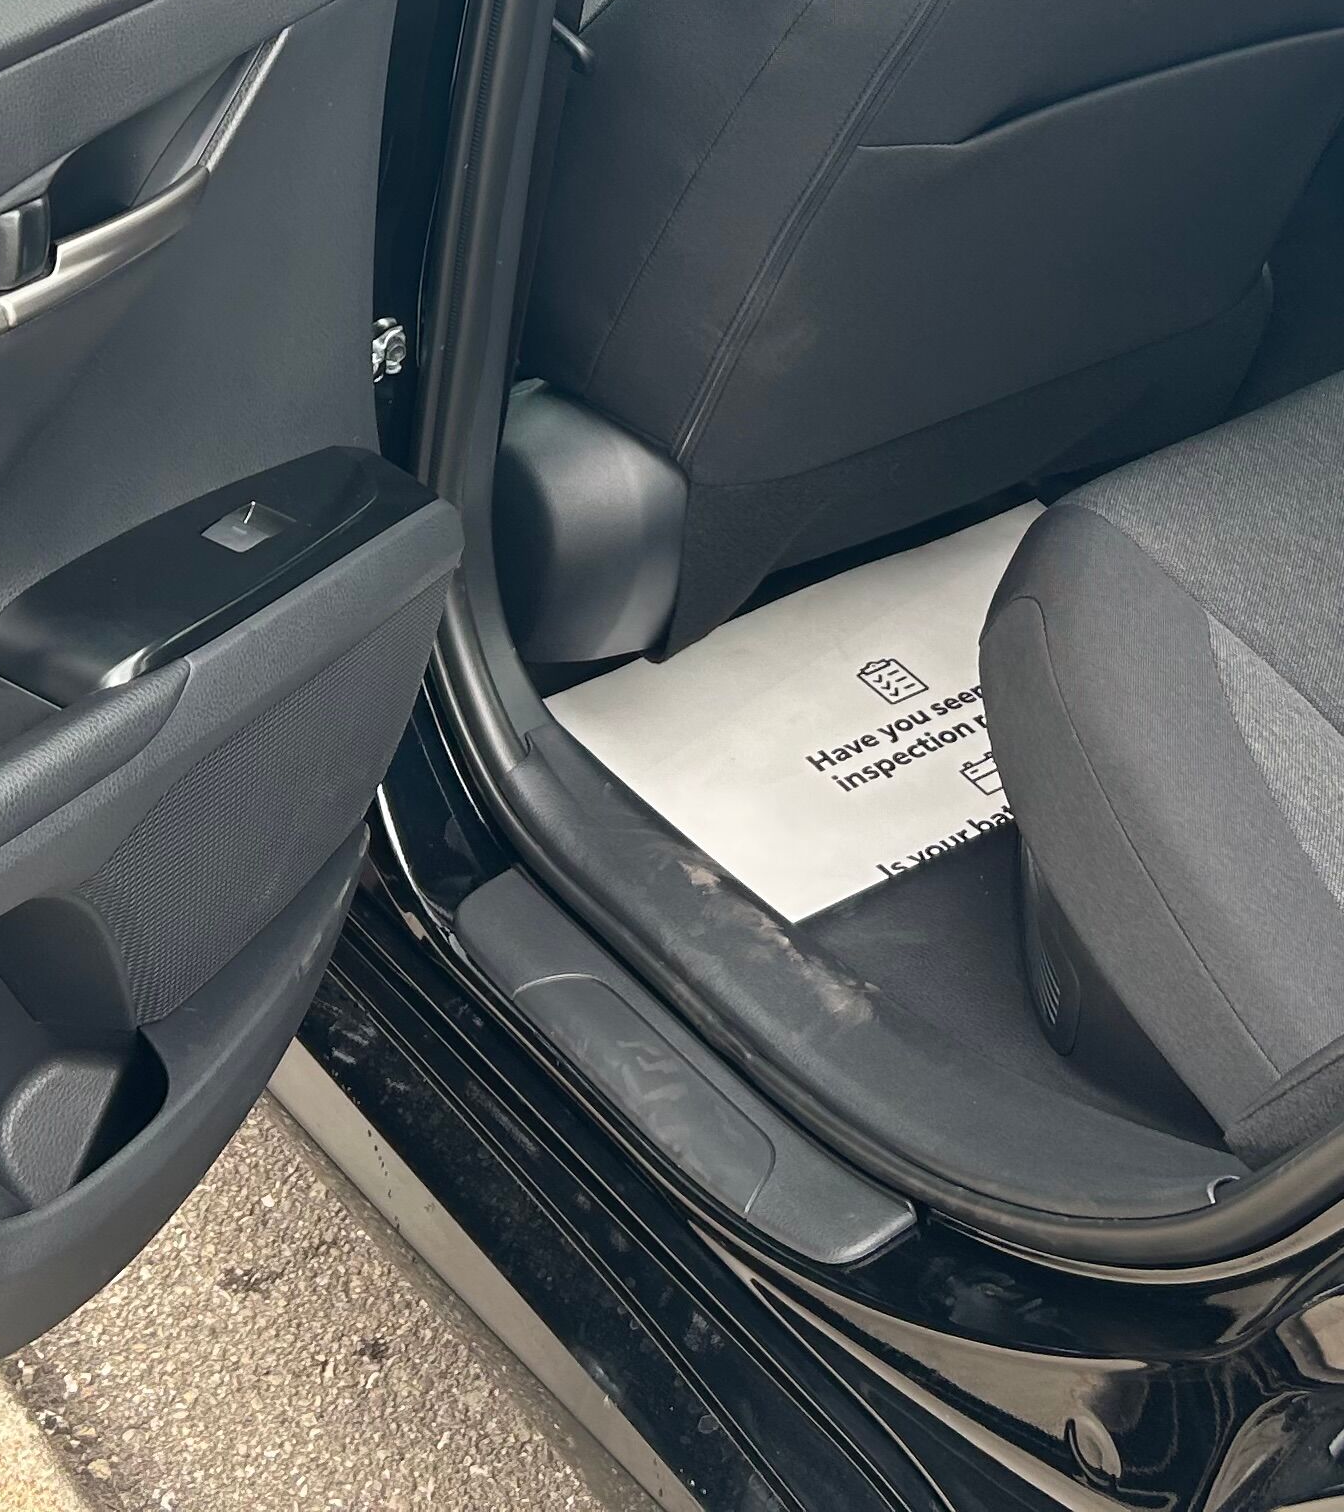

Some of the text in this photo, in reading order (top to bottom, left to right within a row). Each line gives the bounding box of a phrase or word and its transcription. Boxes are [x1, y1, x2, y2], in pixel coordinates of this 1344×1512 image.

[805, 731, 881, 773] Have
[877, 709, 933, 743] you
[831, 722, 977, 793] inspection
